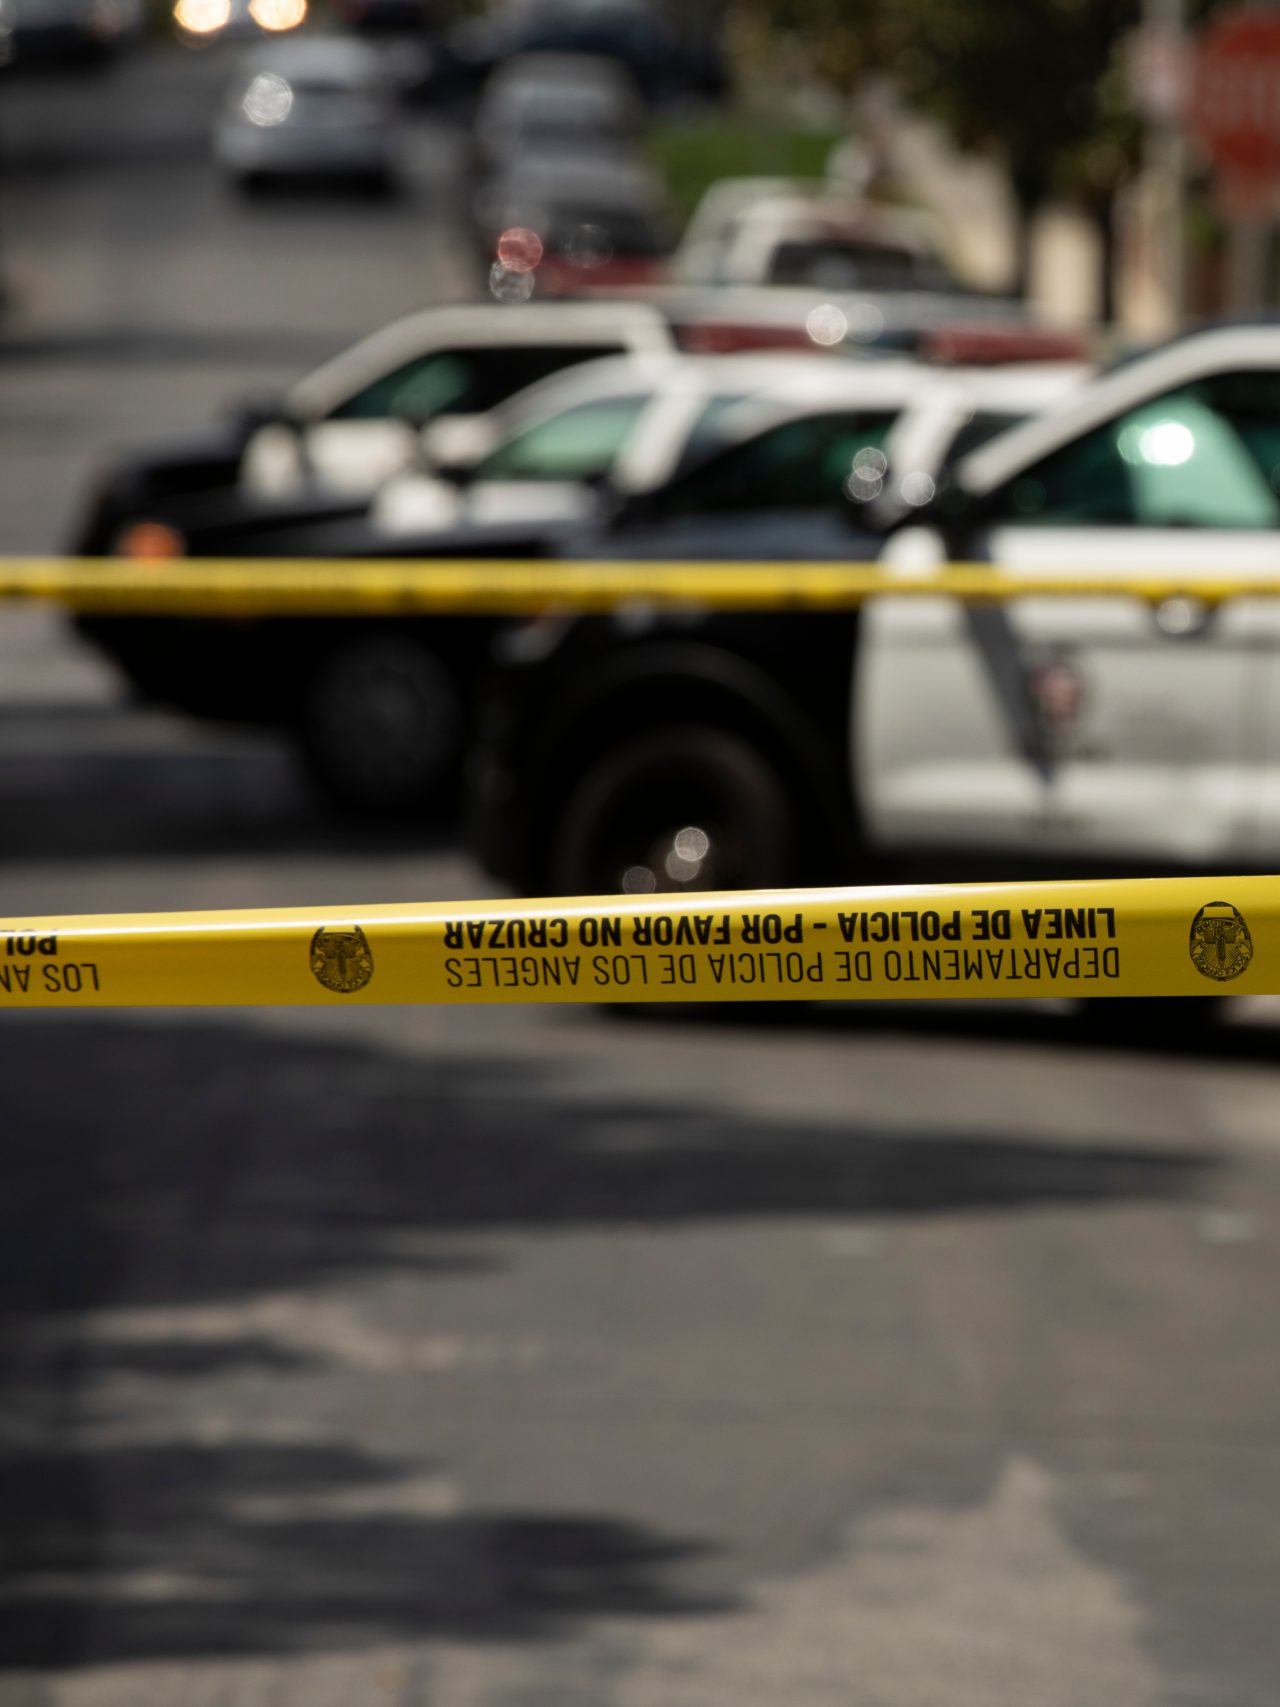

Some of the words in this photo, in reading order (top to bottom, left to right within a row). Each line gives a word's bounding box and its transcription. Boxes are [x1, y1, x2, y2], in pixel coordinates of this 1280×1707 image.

[443, 918, 569, 949] CRUZAR
[579, 917, 622, 948] NO
[632, 914, 731, 946] FAVOR
[741, 914, 803, 944] POR
[838, 911, 962, 943] POLICIA
[971, 910, 1012, 940] DE
[1021, 908, 1116, 939] LINEA
[42, 963, 99, 992] LOS
[445, 956, 580, 987] ANGELES
[592, 955, 647, 985] LOS
[658, 954, 696, 984] DE
[707, 952, 823, 983] POLICIA
[834, 951, 872, 982] DE
[884, 947, 1119, 981] DEPARTAMENTO
